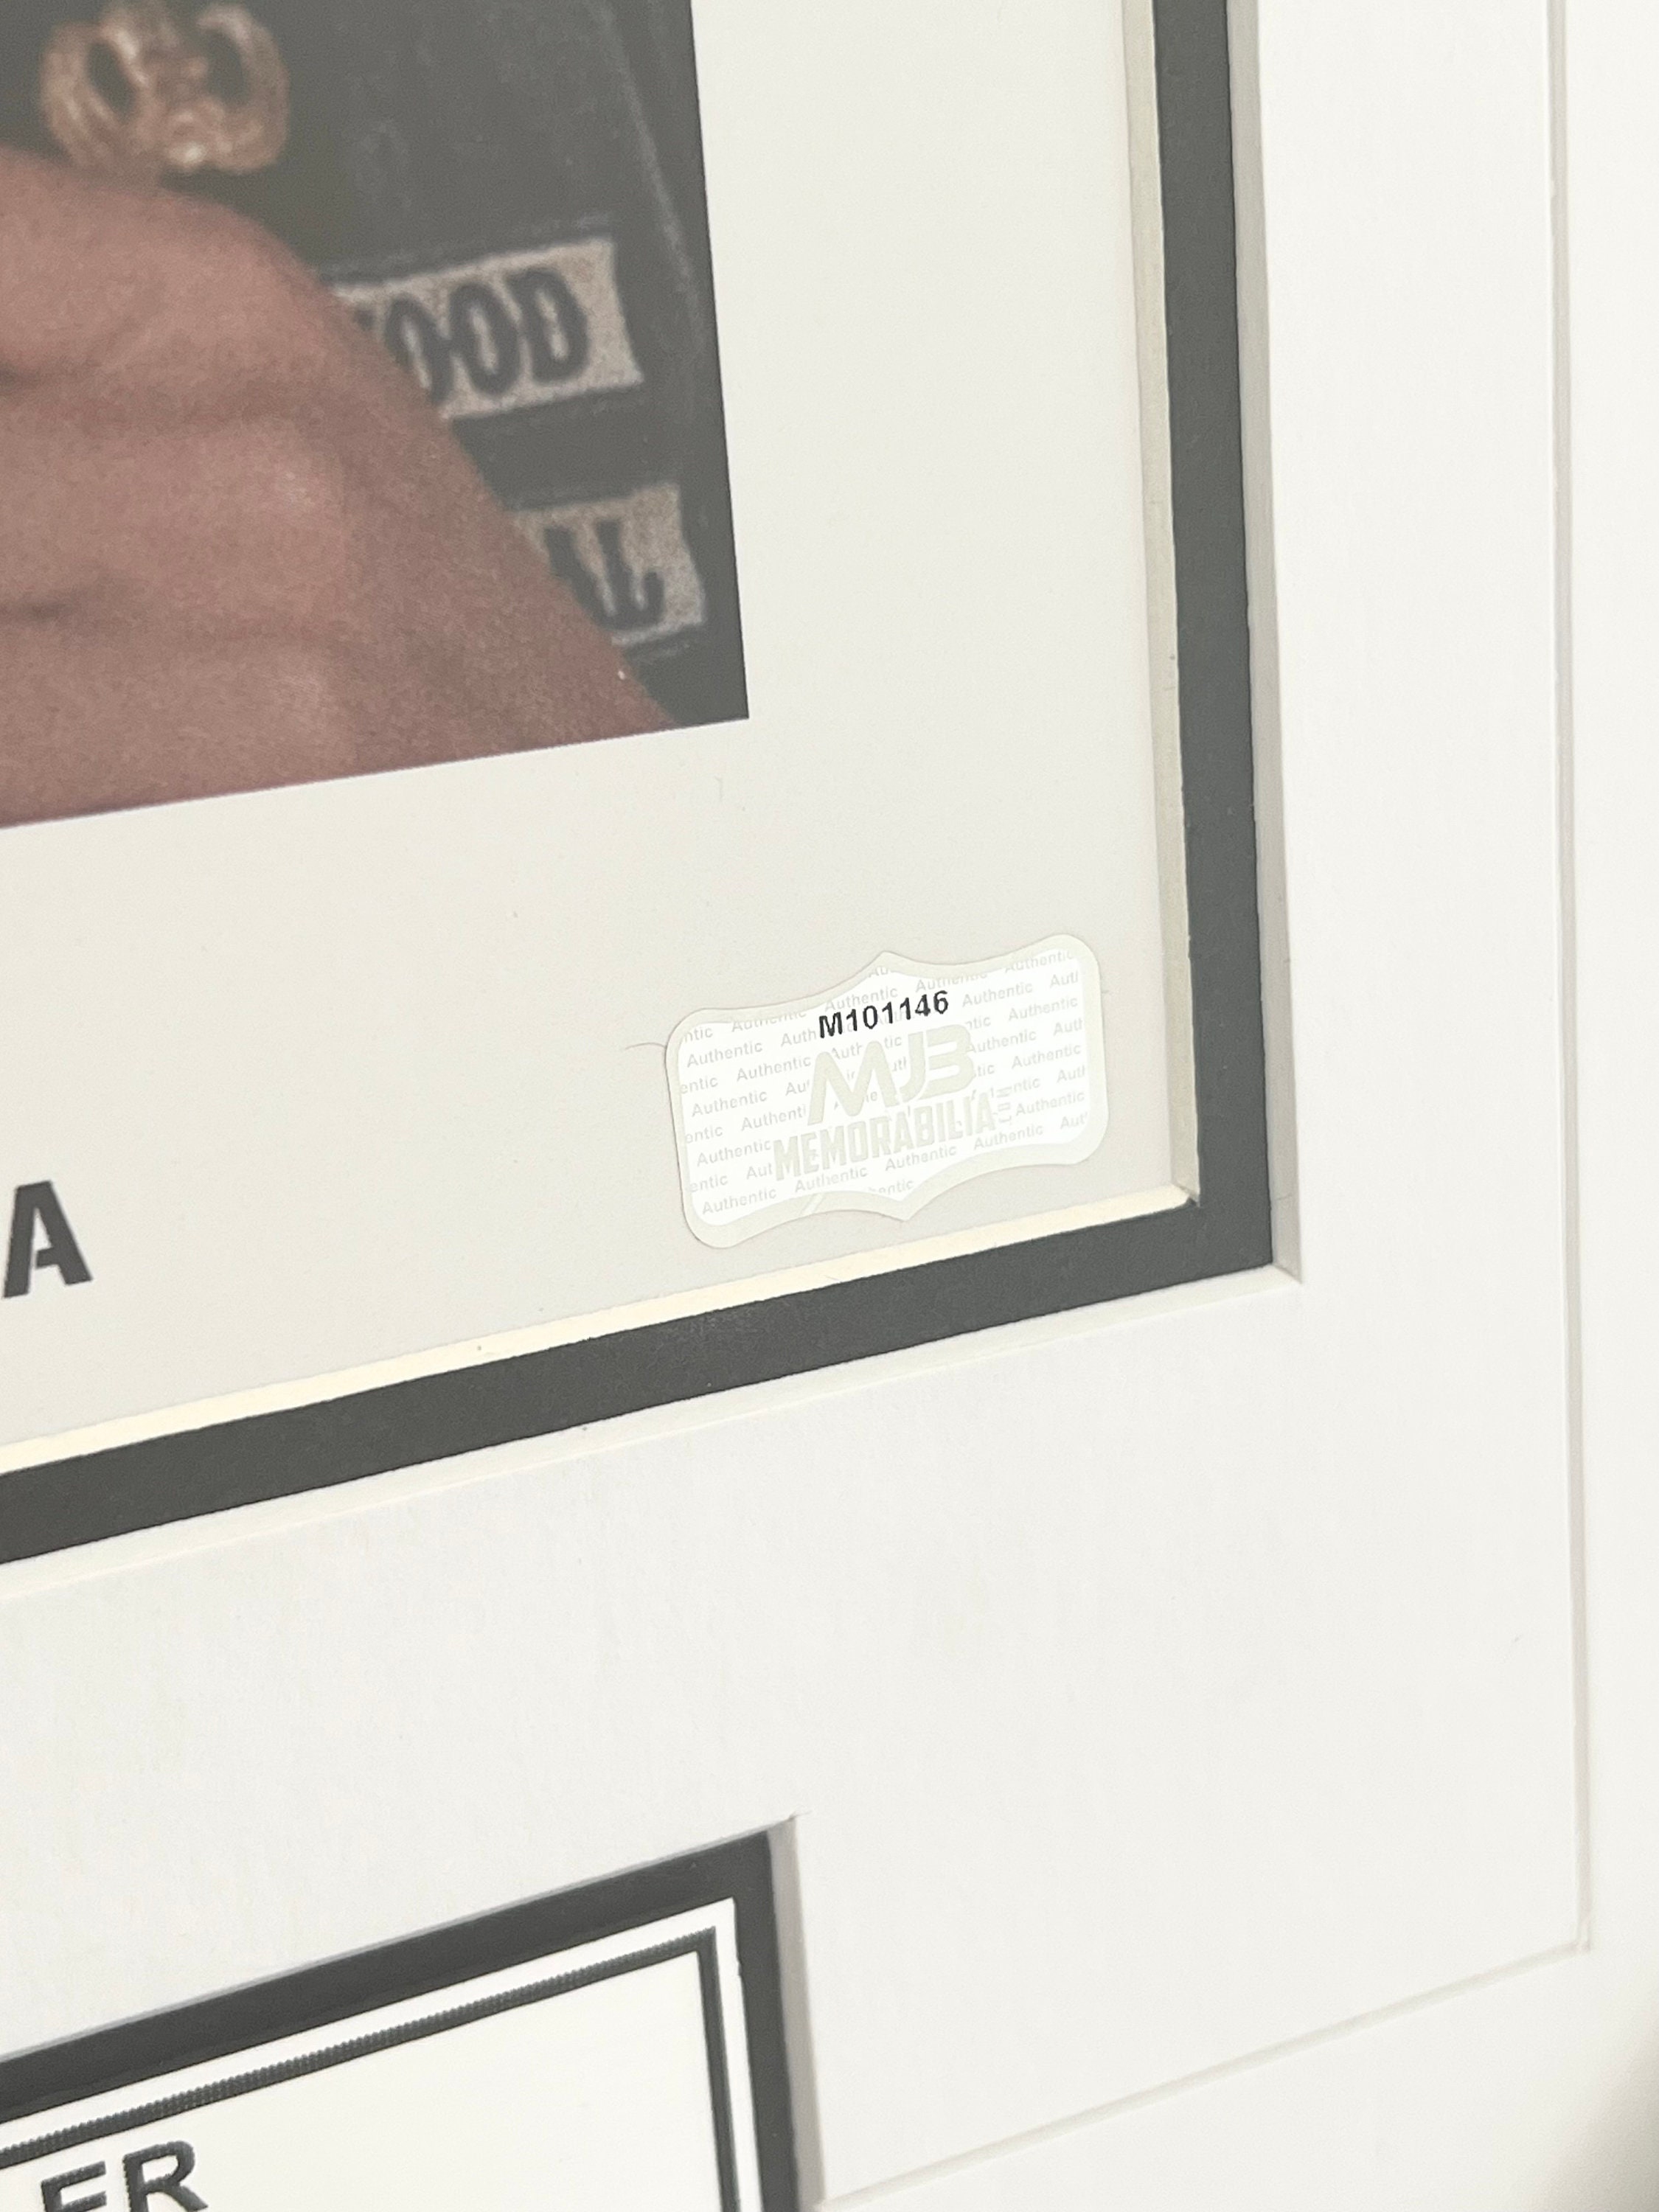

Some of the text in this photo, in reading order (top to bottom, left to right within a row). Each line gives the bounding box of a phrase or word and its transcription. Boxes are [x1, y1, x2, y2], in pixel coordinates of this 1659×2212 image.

[354, 268, 589, 404] OOD
[687, 1042, 762, 1067] Authentic
[962, 982, 1033, 1006] Authentic
[737, 1057, 811, 1081] Authentic
[1009, 997, 1078, 1021] Authentic
[818, 990, 949, 1039] M101146
[825, 987, 898, 1012] Authentic
[692, 1091, 768, 1117] Authentic
[966, 1029, 1037, 1053] Authentic
[807, 1023, 975, 1126] MJB
[1012, 1045, 1081, 1069] Authentic
[773, 1091, 996, 1181] MEMORABILIA
[1016, 1091, 1085, 1116] Authentic
[697, 1140, 771, 1166] Authentic
[703, 1188, 776, 1214] Authentic
[795, 1166, 868, 1193] Authentic
[886, 1145, 956, 1171] Authentic
[974, 1125, 1043, 1150] Authentic
[3, 1180, 93, 1298] A
[41, 2140, 209, 2212] ER
